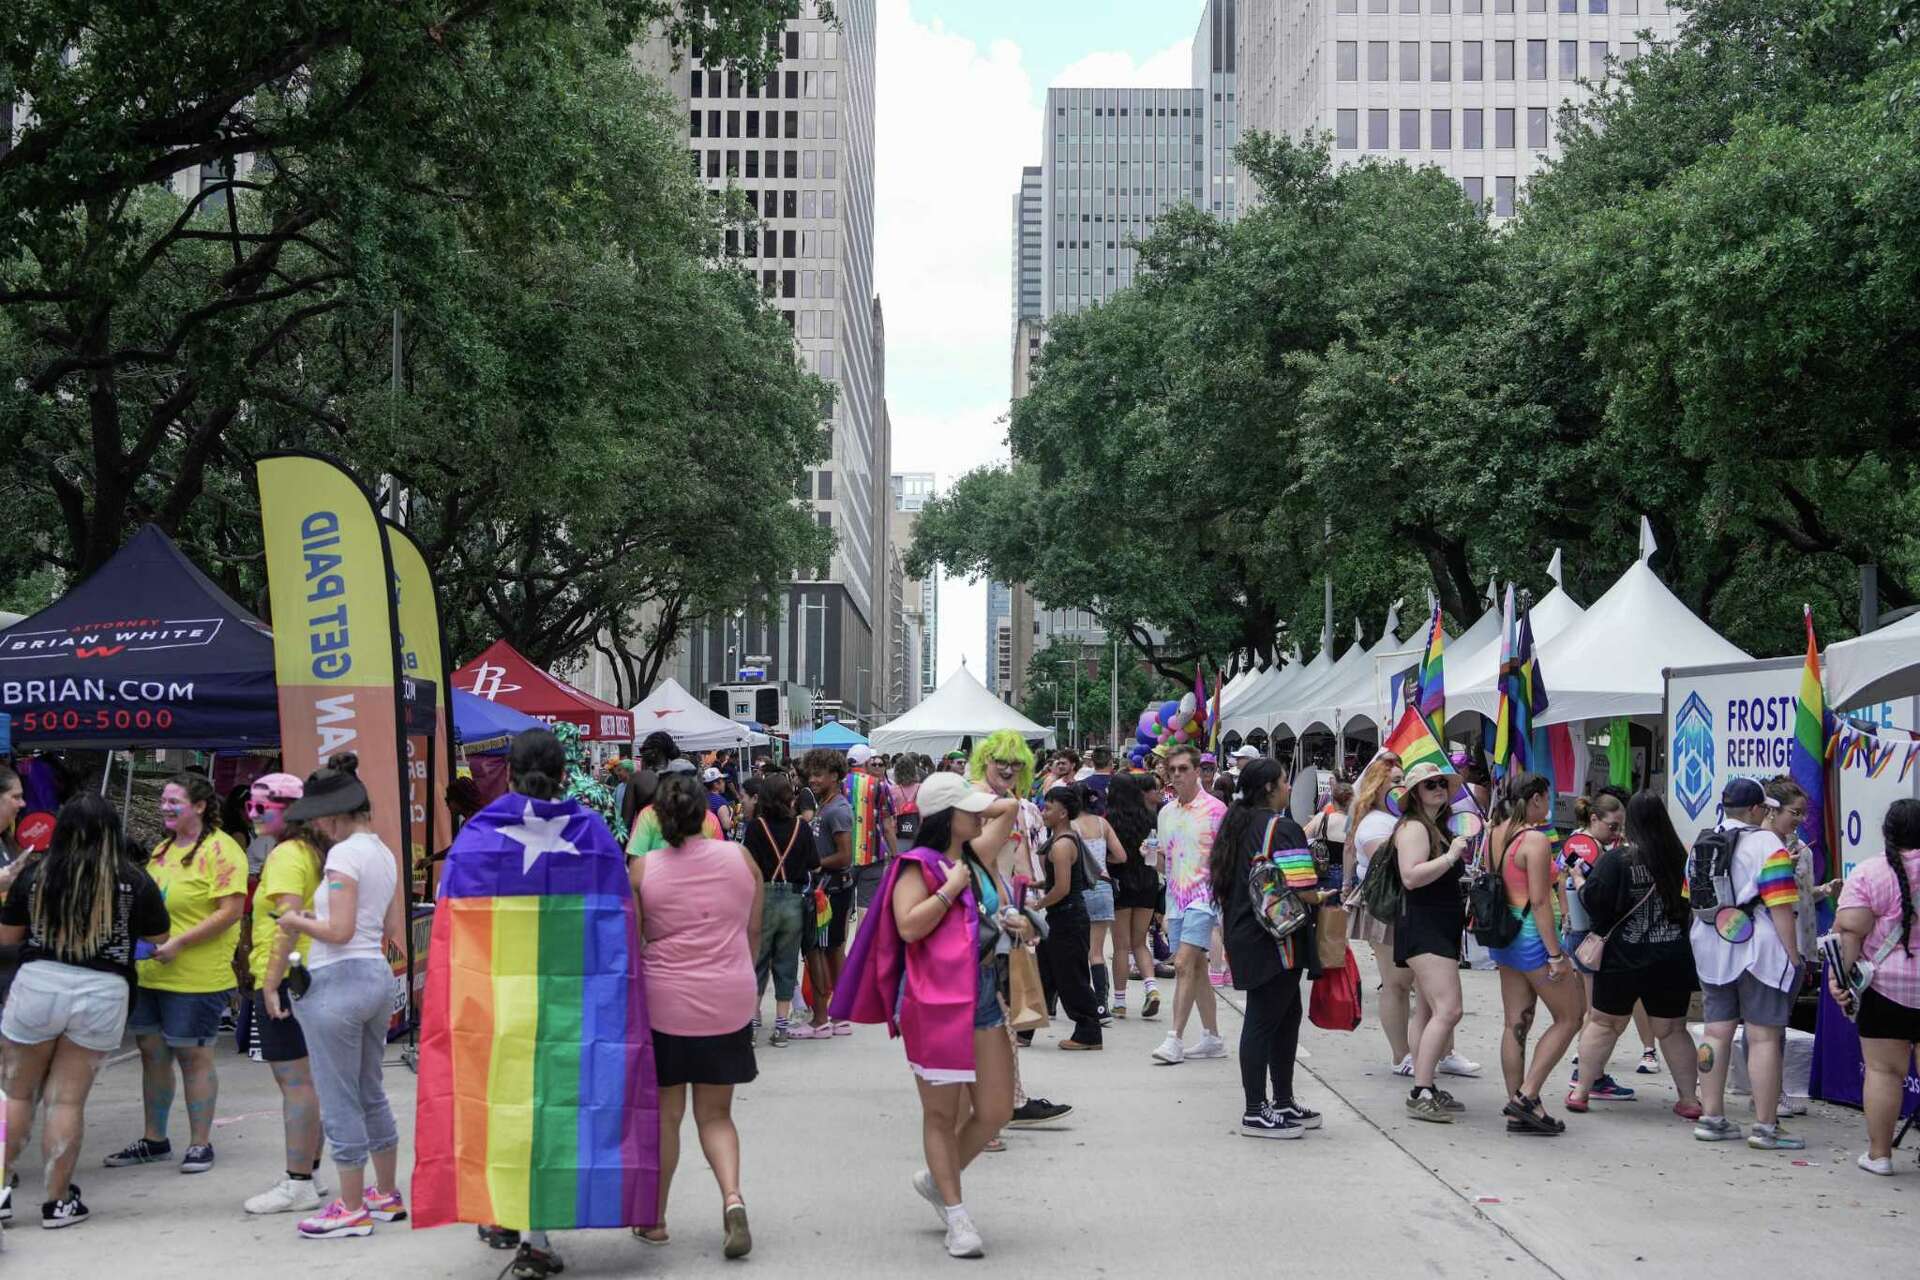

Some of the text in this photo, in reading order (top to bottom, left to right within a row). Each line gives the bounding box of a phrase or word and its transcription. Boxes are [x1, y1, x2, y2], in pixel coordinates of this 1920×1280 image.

[72, 619, 160, 632] ATTORNEY
[11, 629, 205, 650] BRIAN WHITE
